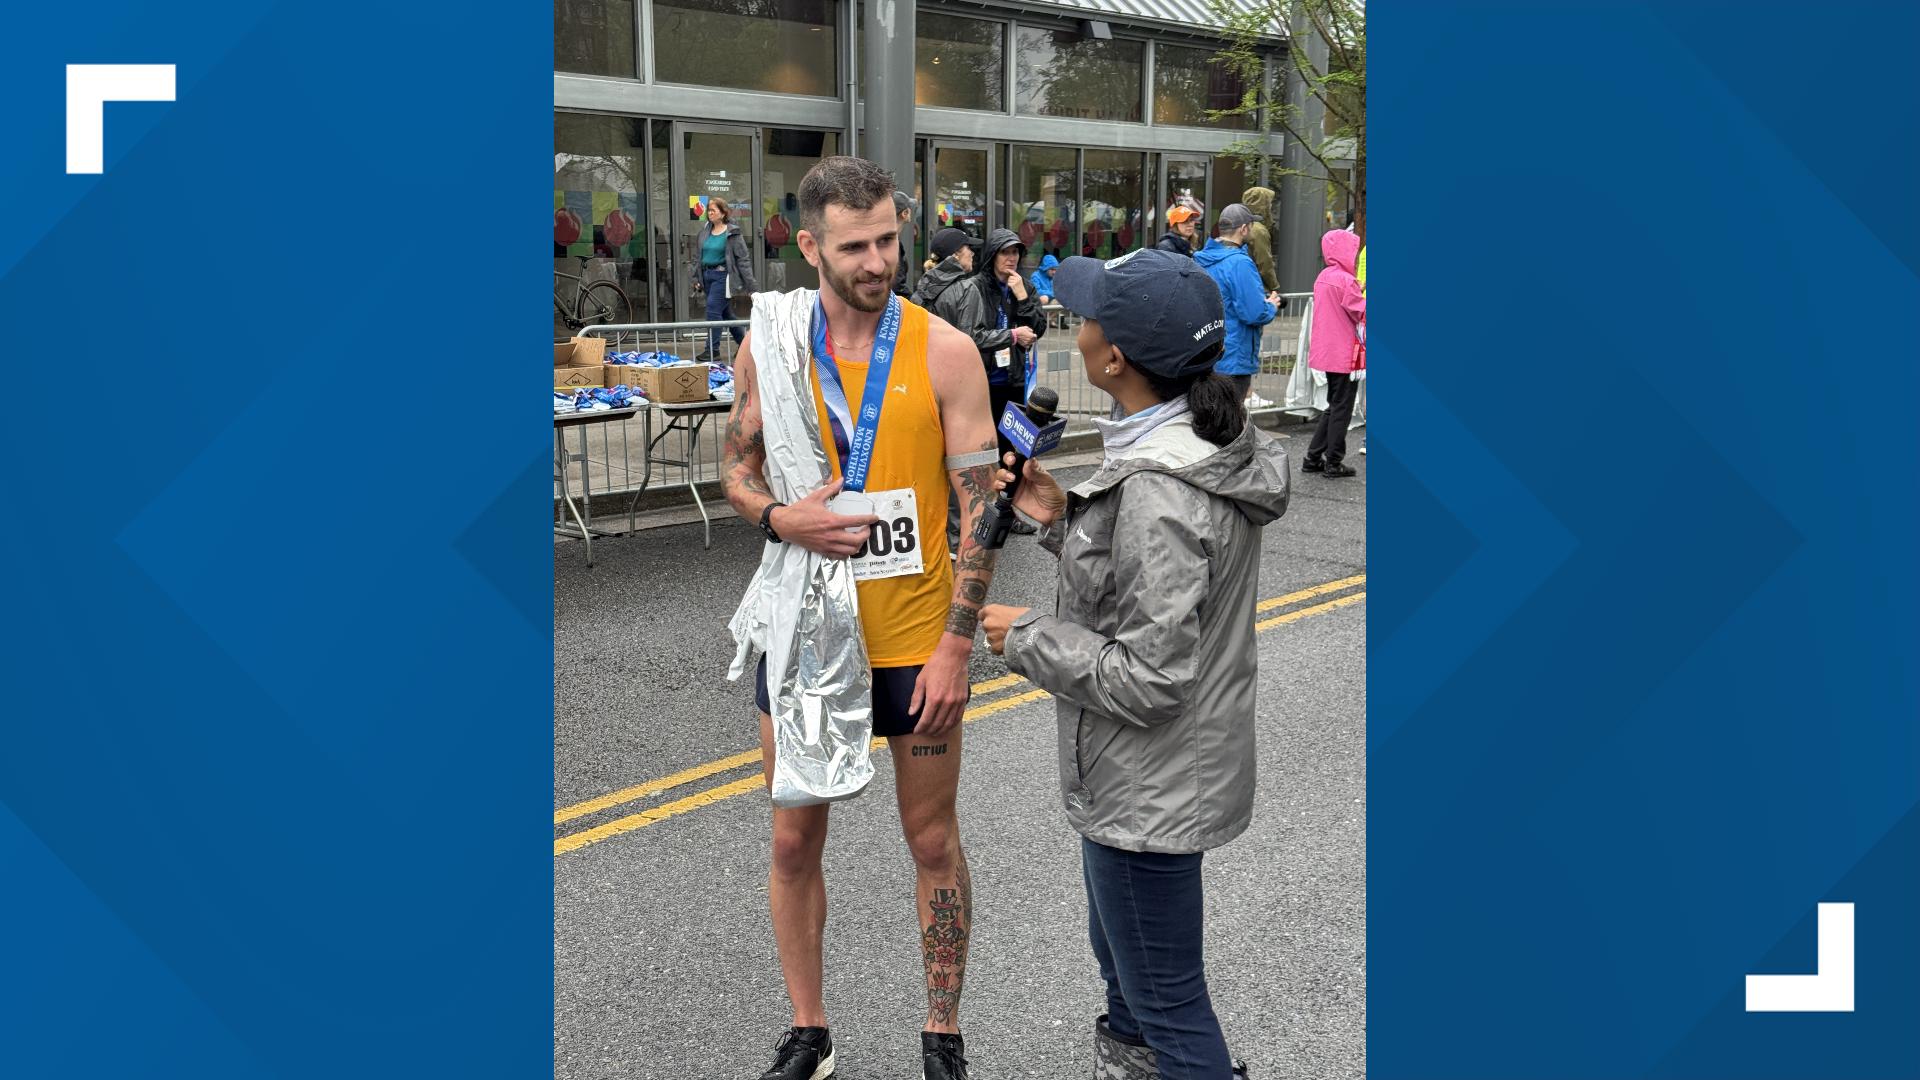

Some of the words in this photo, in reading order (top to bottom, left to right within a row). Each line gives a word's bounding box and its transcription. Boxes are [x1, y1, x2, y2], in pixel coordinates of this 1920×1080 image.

[879, 292, 895, 339] KNOXVI
[888, 297, 900, 342] MARATH
[1004, 412, 1013, 428] 6
[1013, 420, 1035, 445] NEWS
[845, 426, 865, 485] MARATHON
[855, 428, 874, 485] KNOXVILLE
